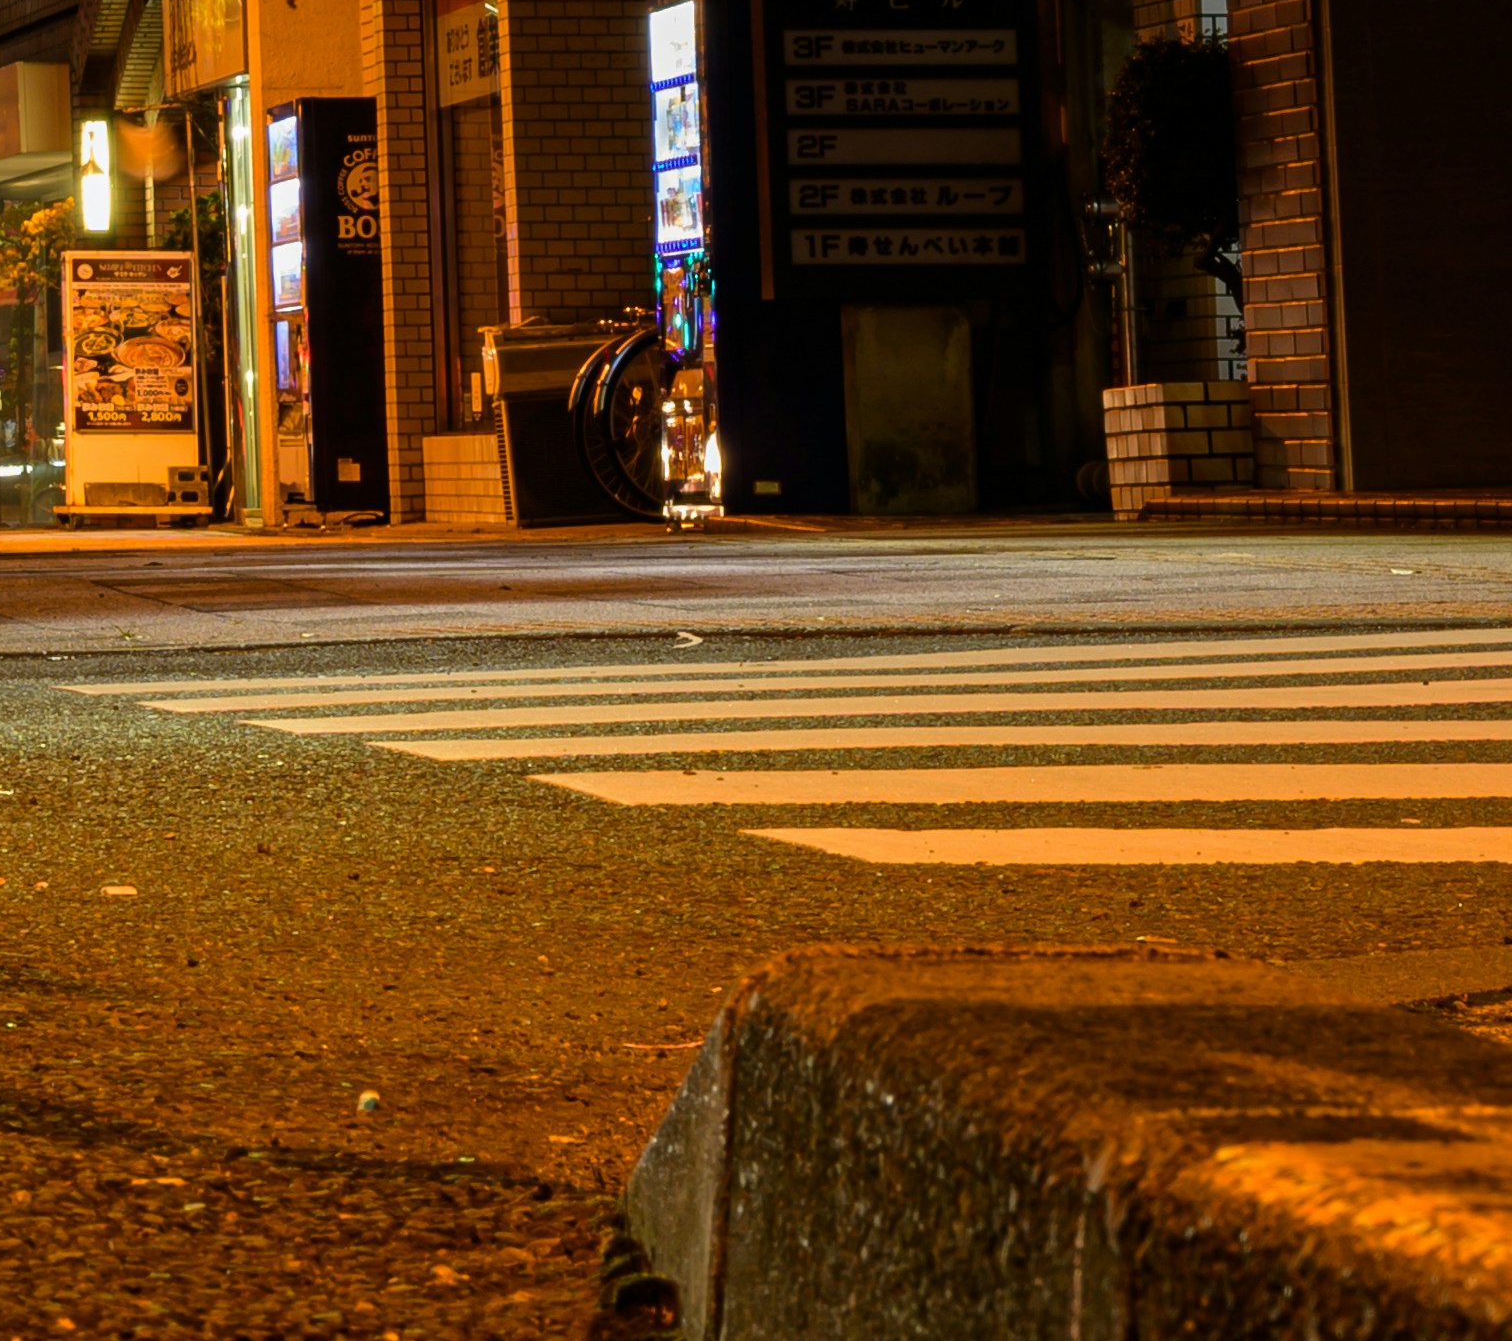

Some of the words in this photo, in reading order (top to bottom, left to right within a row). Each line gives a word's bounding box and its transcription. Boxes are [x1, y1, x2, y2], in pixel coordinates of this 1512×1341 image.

[792, 36, 834, 58] 3F
[795, 85, 836, 109] 3F
[796, 135, 838, 159] 2F
[798, 184, 840, 208] 2F
[850, 186, 927, 206] 株式会社
[802, 235, 841, 259] 1F
